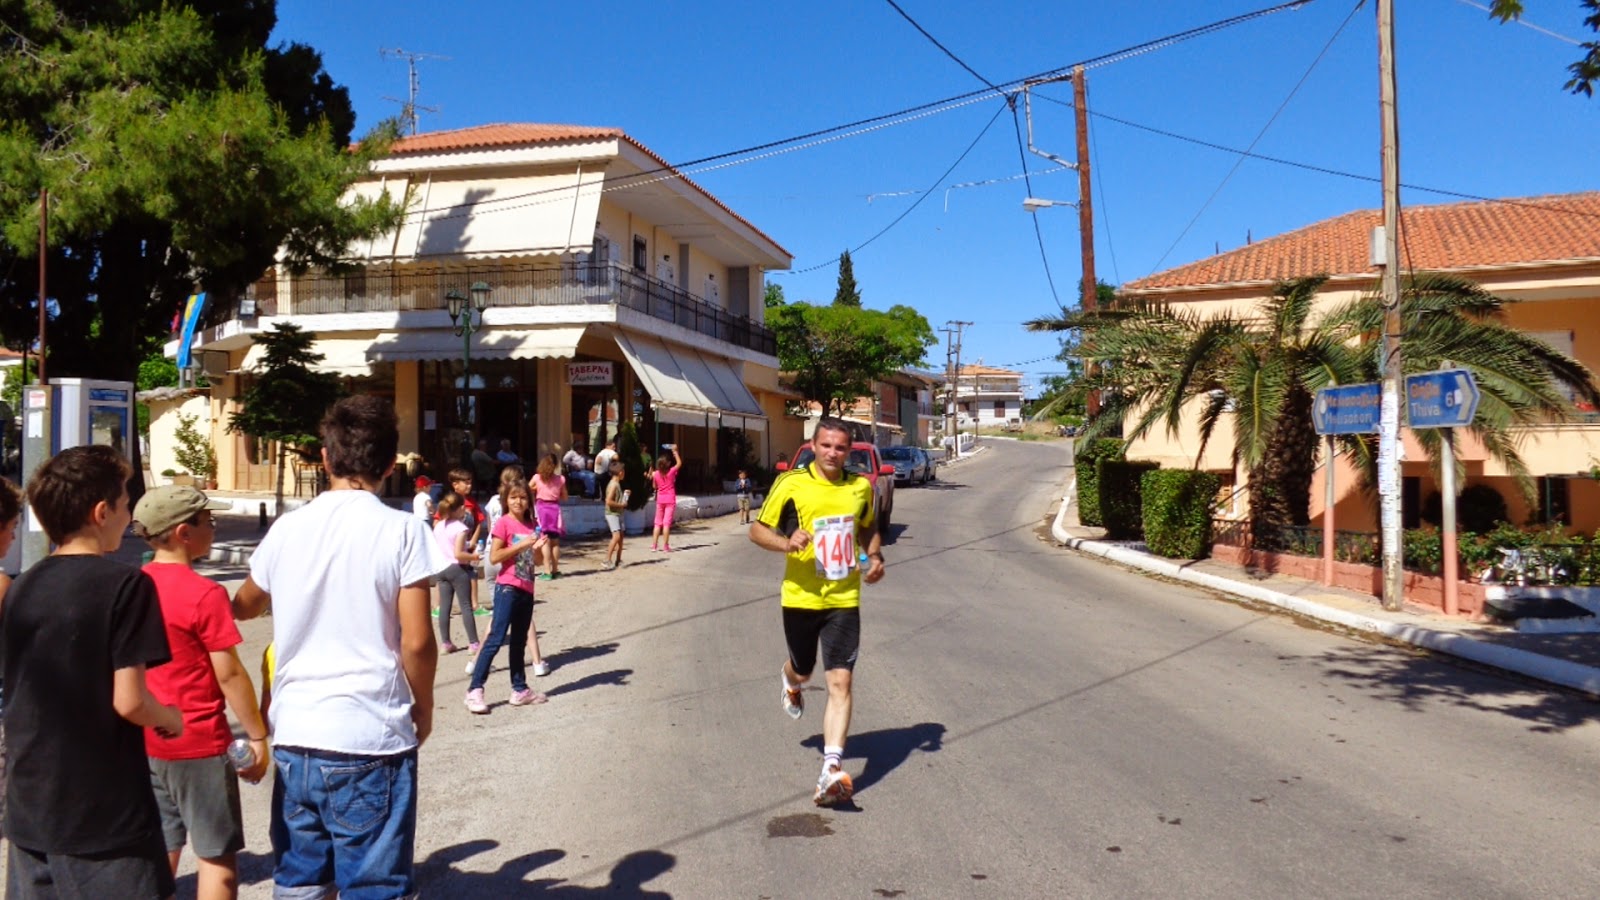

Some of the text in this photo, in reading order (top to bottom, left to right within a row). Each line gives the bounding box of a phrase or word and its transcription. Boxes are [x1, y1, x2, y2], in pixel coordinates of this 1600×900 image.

[570, 365, 609, 375] ΤΑΒΕΡΝΑ
[1410, 381, 1440, 399] Θήβα
[1411, 402, 1440, 416] Thiva
[817, 532, 853, 568] 140
